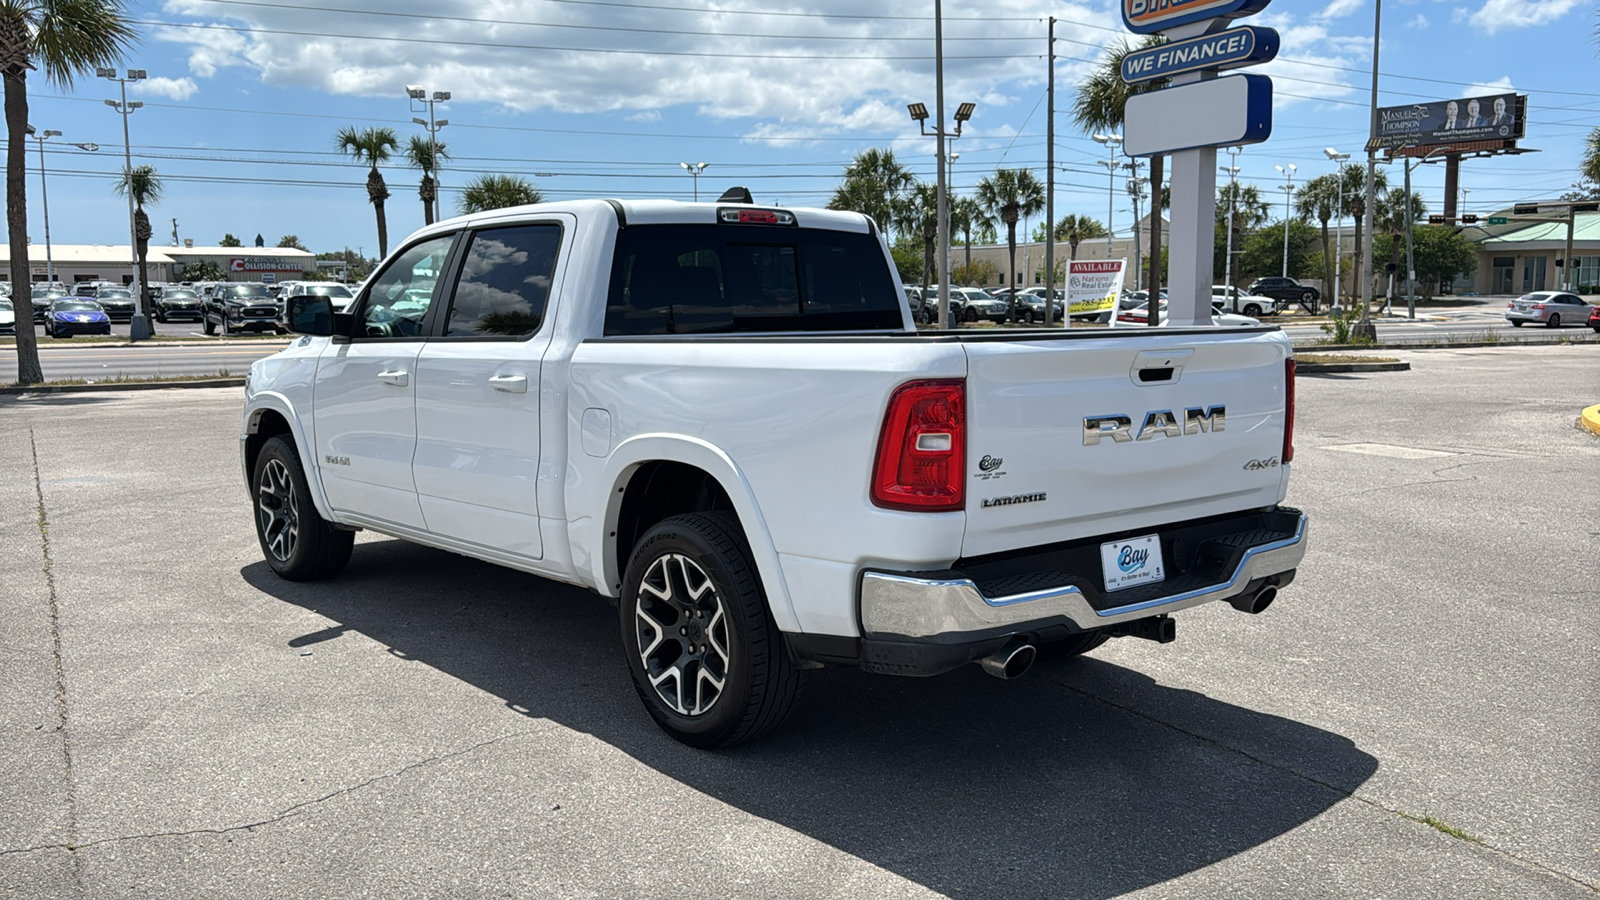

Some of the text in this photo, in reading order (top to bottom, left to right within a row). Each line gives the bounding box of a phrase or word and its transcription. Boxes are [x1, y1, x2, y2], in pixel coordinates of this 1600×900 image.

[1127, 35, 1247, 75] WE FINANCE!
[1381, 120, 1420, 131] THOMPSON
[1072, 262, 1119, 272] AVAILABLE
[1082, 404, 1226, 446] RAM
[979, 454, 1003, 472] Bay
[1243, 456, 1280, 471] 4x4
[981, 492, 1046, 508] LARAMIE
[1118, 545, 1150, 571] Bay
